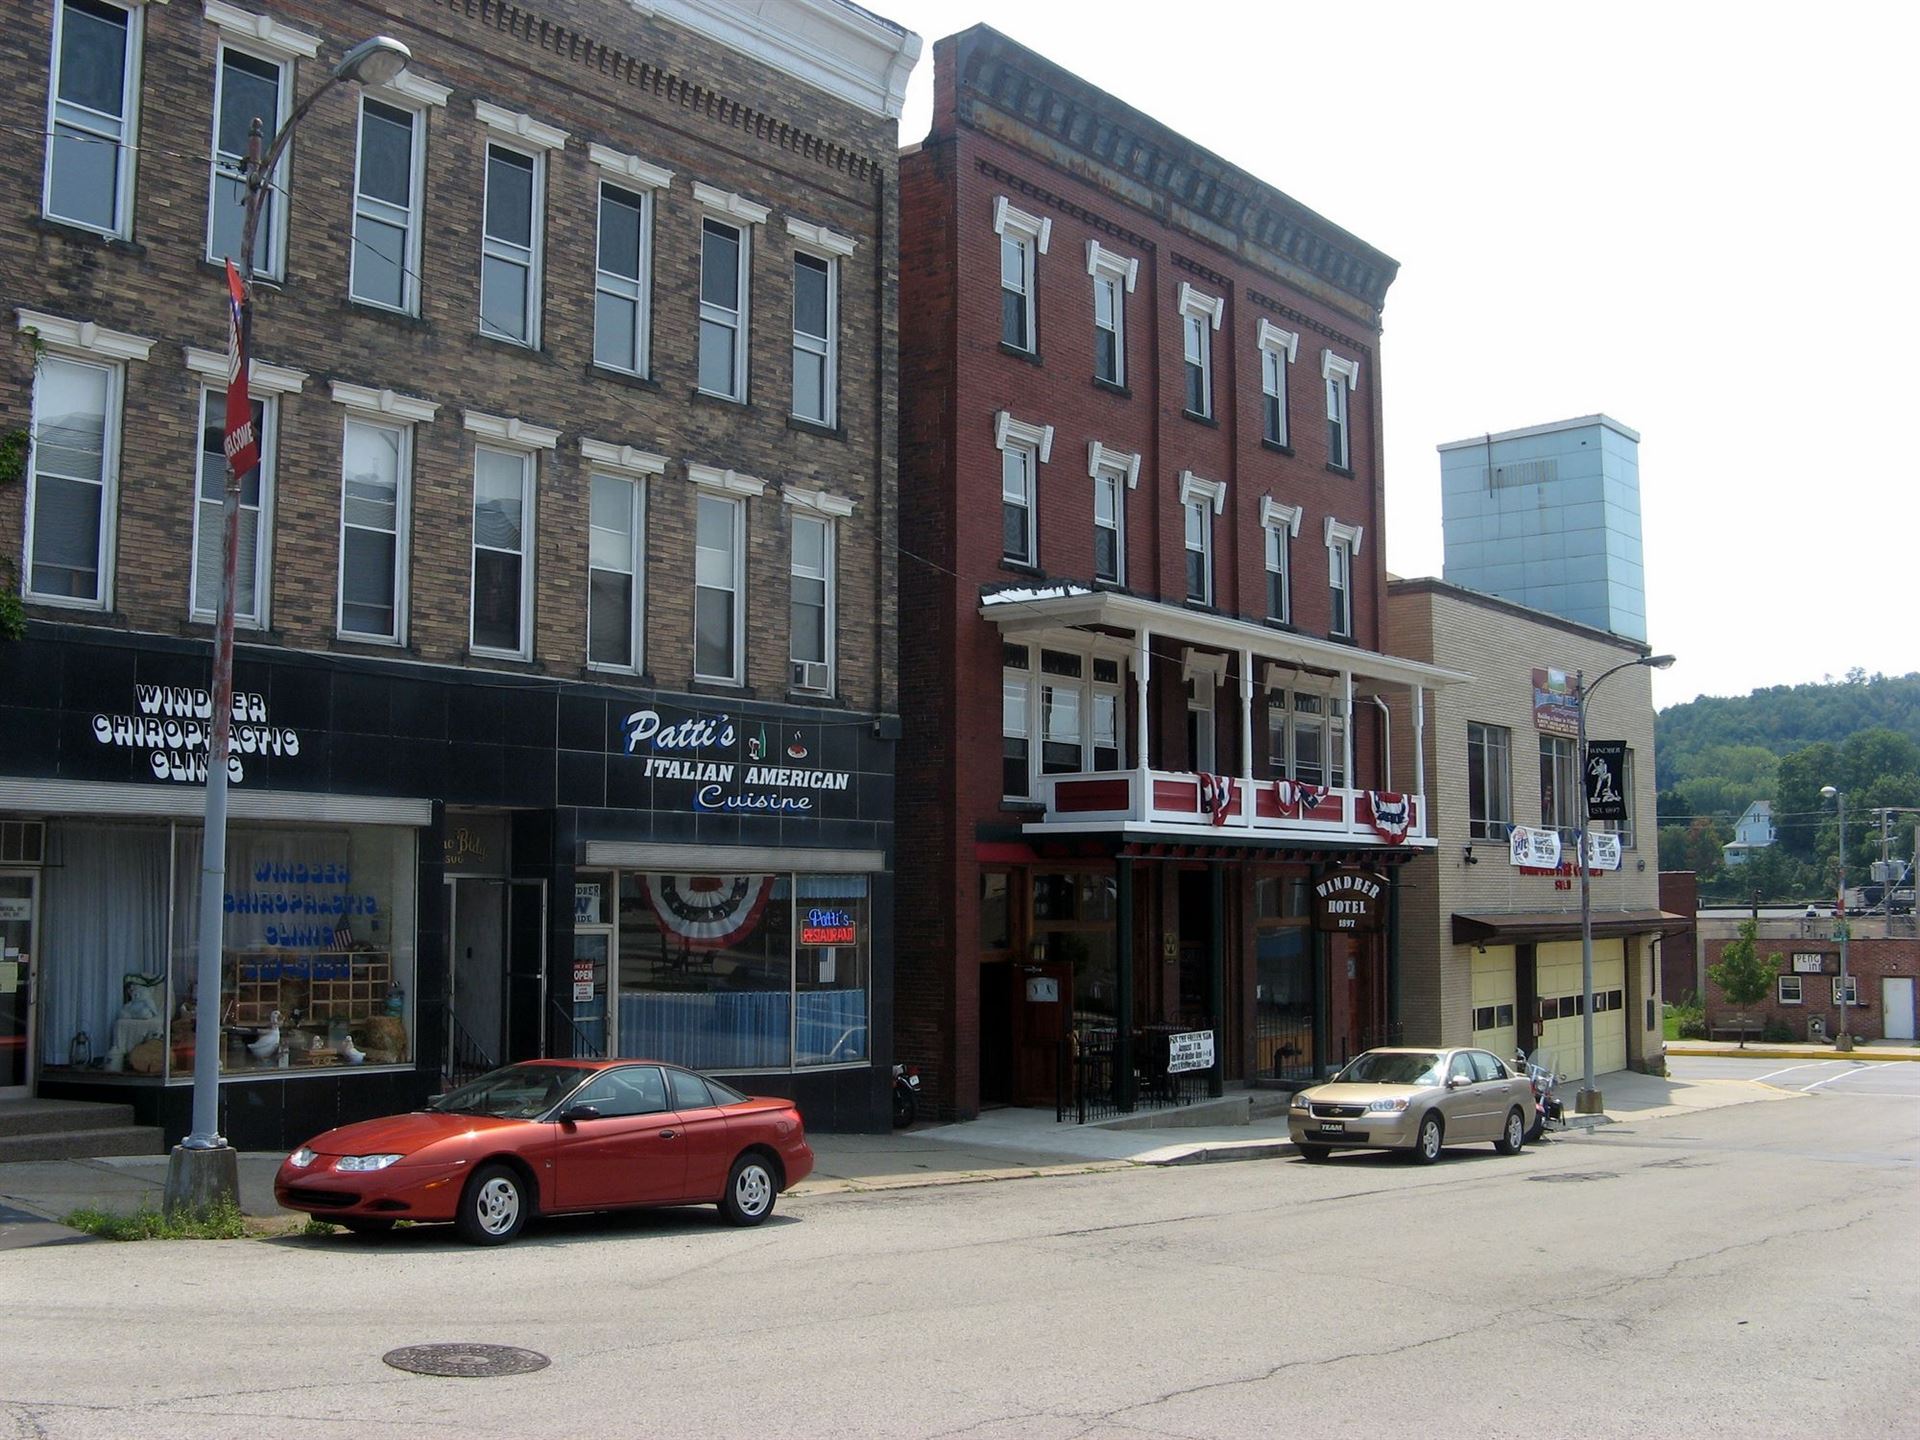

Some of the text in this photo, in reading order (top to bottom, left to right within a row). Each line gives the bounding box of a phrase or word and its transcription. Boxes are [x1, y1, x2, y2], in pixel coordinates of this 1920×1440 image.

[136, 684, 267, 722] WINDER
[623, 710, 736, 754] Patti's
[151, 750, 244, 783] CLINC
[643, 758, 849, 791] ITALIAN AMERICAN
[696, 784, 813, 811] Cuisine
[255, 860, 351, 884] WINDBER
[1316, 875, 1380, 899] WINDBER
[808, 908, 850, 927] Patti's
[1328, 900, 1366, 914] HOTEL
[803, 927, 853, 942] RESTAURANT
[573, 970, 593, 981] OPEN
